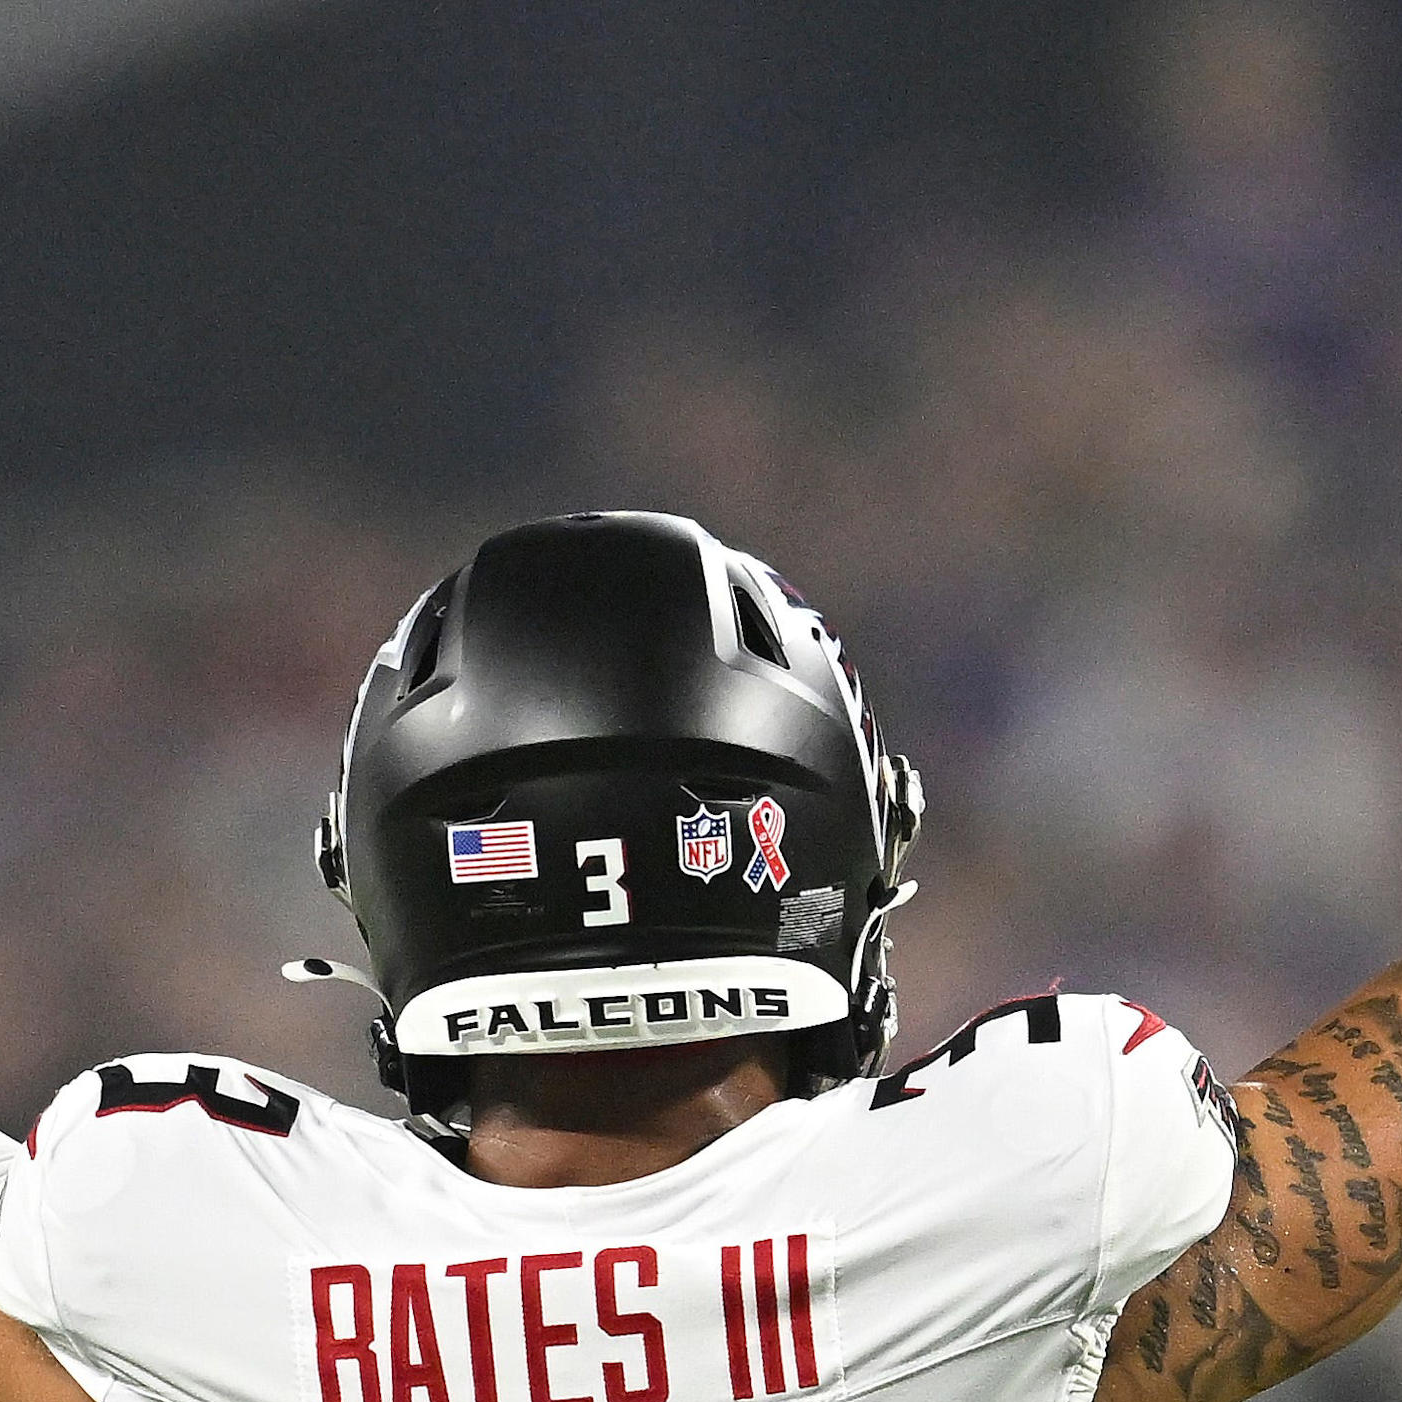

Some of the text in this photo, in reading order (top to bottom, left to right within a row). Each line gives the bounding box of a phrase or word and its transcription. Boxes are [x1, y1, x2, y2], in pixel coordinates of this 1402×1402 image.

[686, 839, 725, 869] NFL
[758, 831, 777, 861] 9/11
[575, 837, 631, 927] 3
[442, 987, 790, 1043] FALCONS
[95, 1063, 300, 1137] 3
[720, 1233, 819, 1401] III
